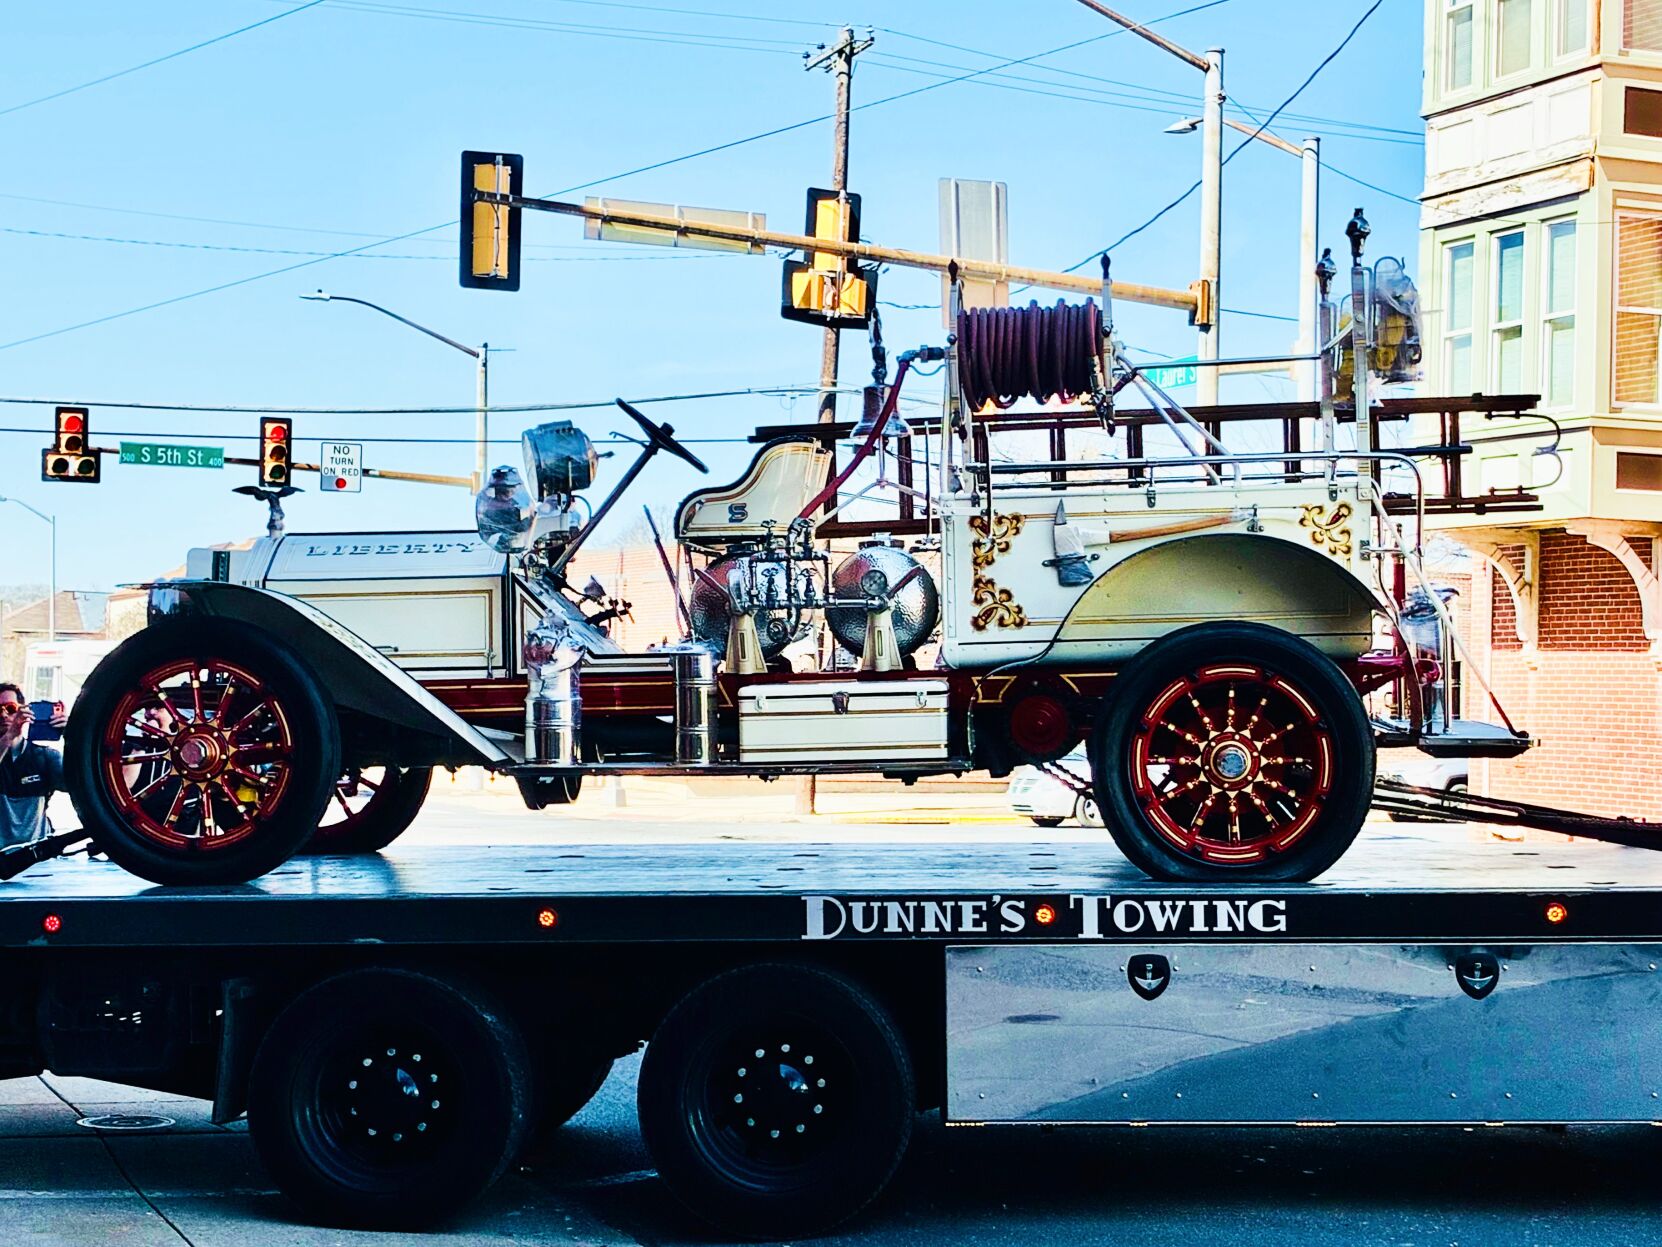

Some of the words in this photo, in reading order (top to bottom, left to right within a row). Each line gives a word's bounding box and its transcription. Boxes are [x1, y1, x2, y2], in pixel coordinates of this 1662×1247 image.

[122, 453, 135, 463] 500
[140, 446, 151, 463] S
[157, 448, 182, 465] 5th
[187, 449, 204, 465] St
[208, 457, 222, 467] 400
[333, 445, 350, 455] NO
[330, 456, 354, 466] TURN
[323, 466, 336, 476] ON
[341, 467, 359, 477] RED
[728, 502, 749, 524] S
[306, 541, 483, 557] LIBERTY
[801, 894, 1026, 940] DUNNE'S
[1069, 894, 1287, 939] TOWING
